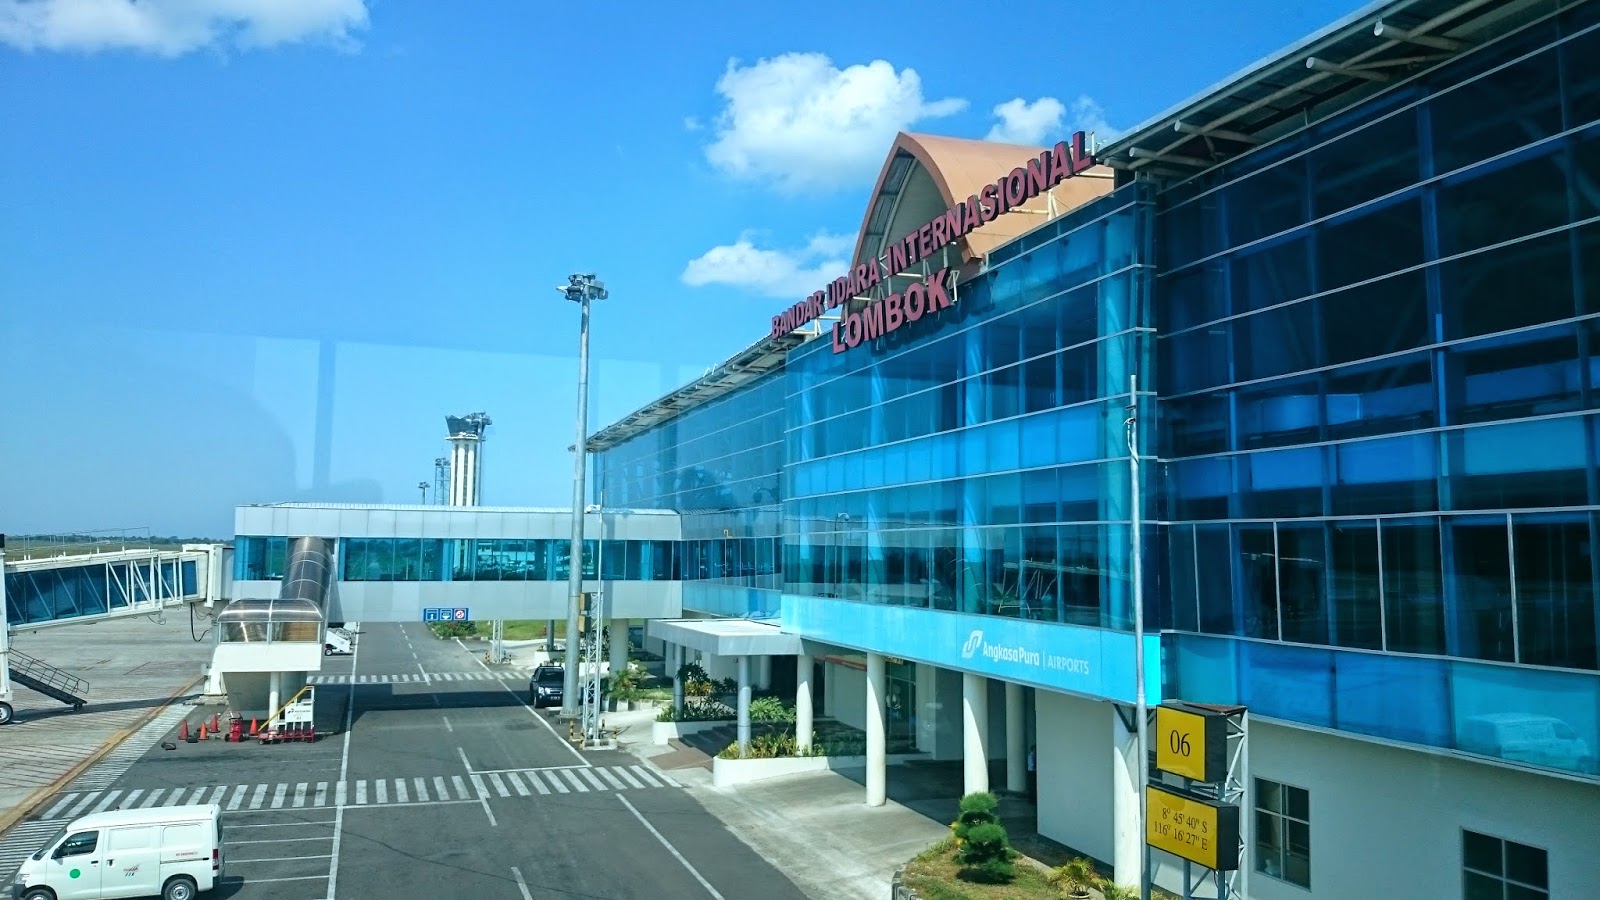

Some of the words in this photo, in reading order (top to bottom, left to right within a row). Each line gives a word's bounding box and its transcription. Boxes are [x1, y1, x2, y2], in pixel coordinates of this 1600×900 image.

[772, 290, 825, 340] BANDAR
[826, 257, 881, 310] UDARA
[886, 131, 1095, 276] INTERNASIONAL
[832, 267, 952, 354] LOMBOK
[1047, 655, 1089, 675] AIRPORTS
[1170, 729, 1191, 757] 06
[1201, 820, 1208, 834] S
[1201, 837, 1208, 851] E
